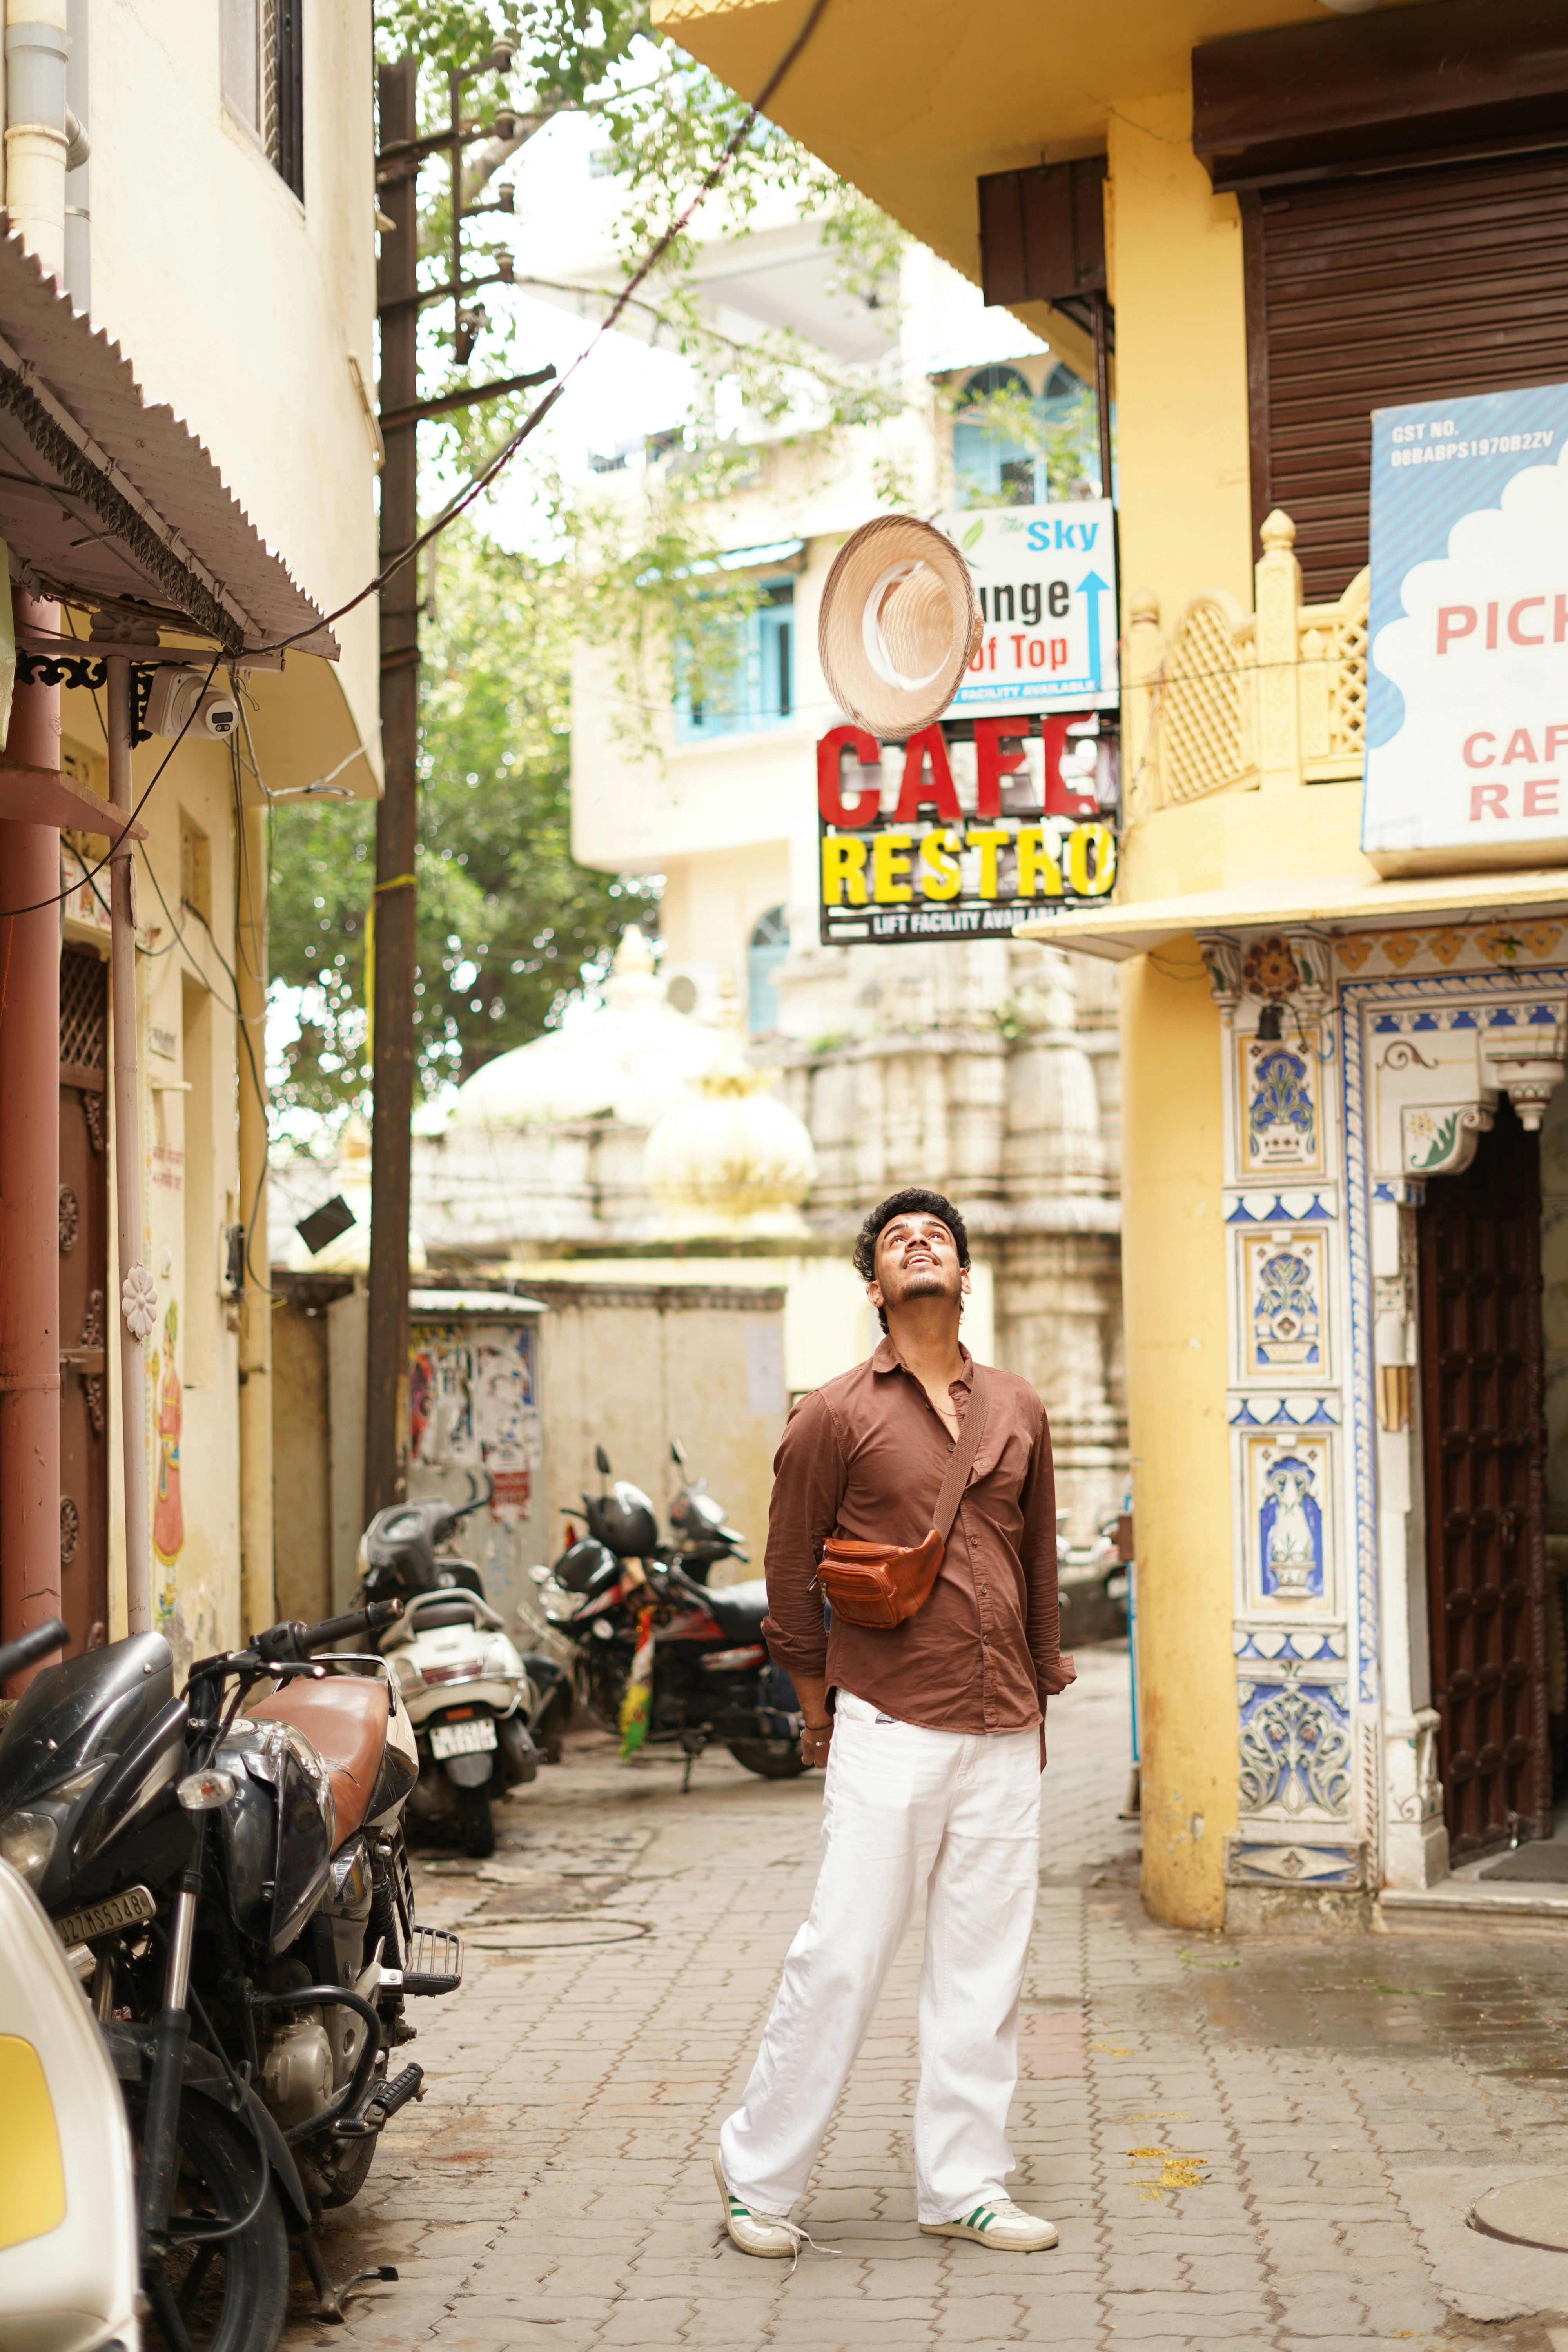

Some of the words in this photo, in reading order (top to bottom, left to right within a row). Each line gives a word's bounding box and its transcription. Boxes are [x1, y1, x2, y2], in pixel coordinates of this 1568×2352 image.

[1392, 423, 1426, 444] GST
[1430, 419, 1459, 439] NO.
[997, 516, 1025, 534] The
[1027, 519, 1099, 552] Sky
[1010, 634, 1067, 670] Top
[961, 685, 1021, 701] FACILITY
[1022, 679, 1095, 697] AVAILABLE
[817, 711, 1099, 828] CAFE
[823, 822, 1116, 906] RESTRO
[873, 914, 909, 935] LIFT
[910, 909, 981, 933] FACILITY
